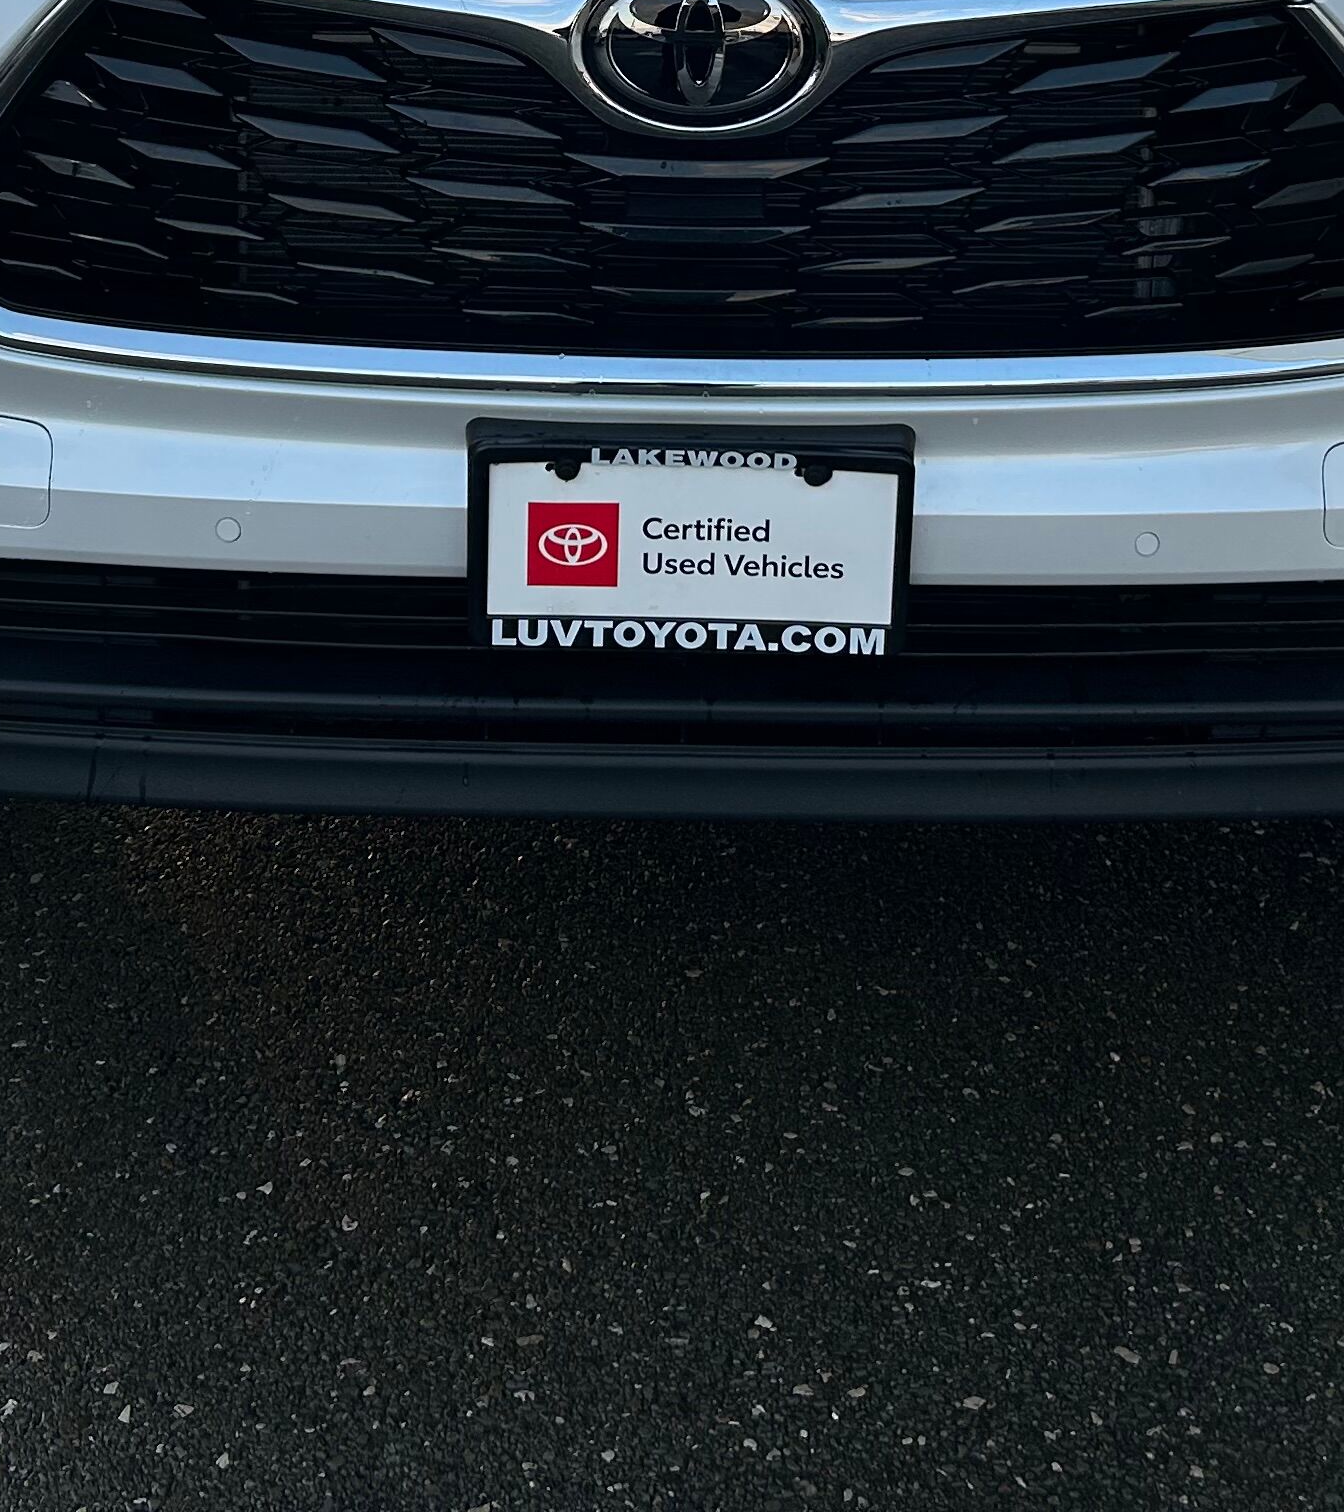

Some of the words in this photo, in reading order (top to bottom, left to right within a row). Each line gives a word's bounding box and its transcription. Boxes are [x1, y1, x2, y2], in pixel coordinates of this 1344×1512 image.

[591, 448, 798, 471] LAKEWOOD
[642, 517, 771, 543] Certified
[642, 552, 717, 576] Used
[723, 553, 844, 579] Vehicles
[491, 618, 886, 656] LUVTOYOTA.COM
